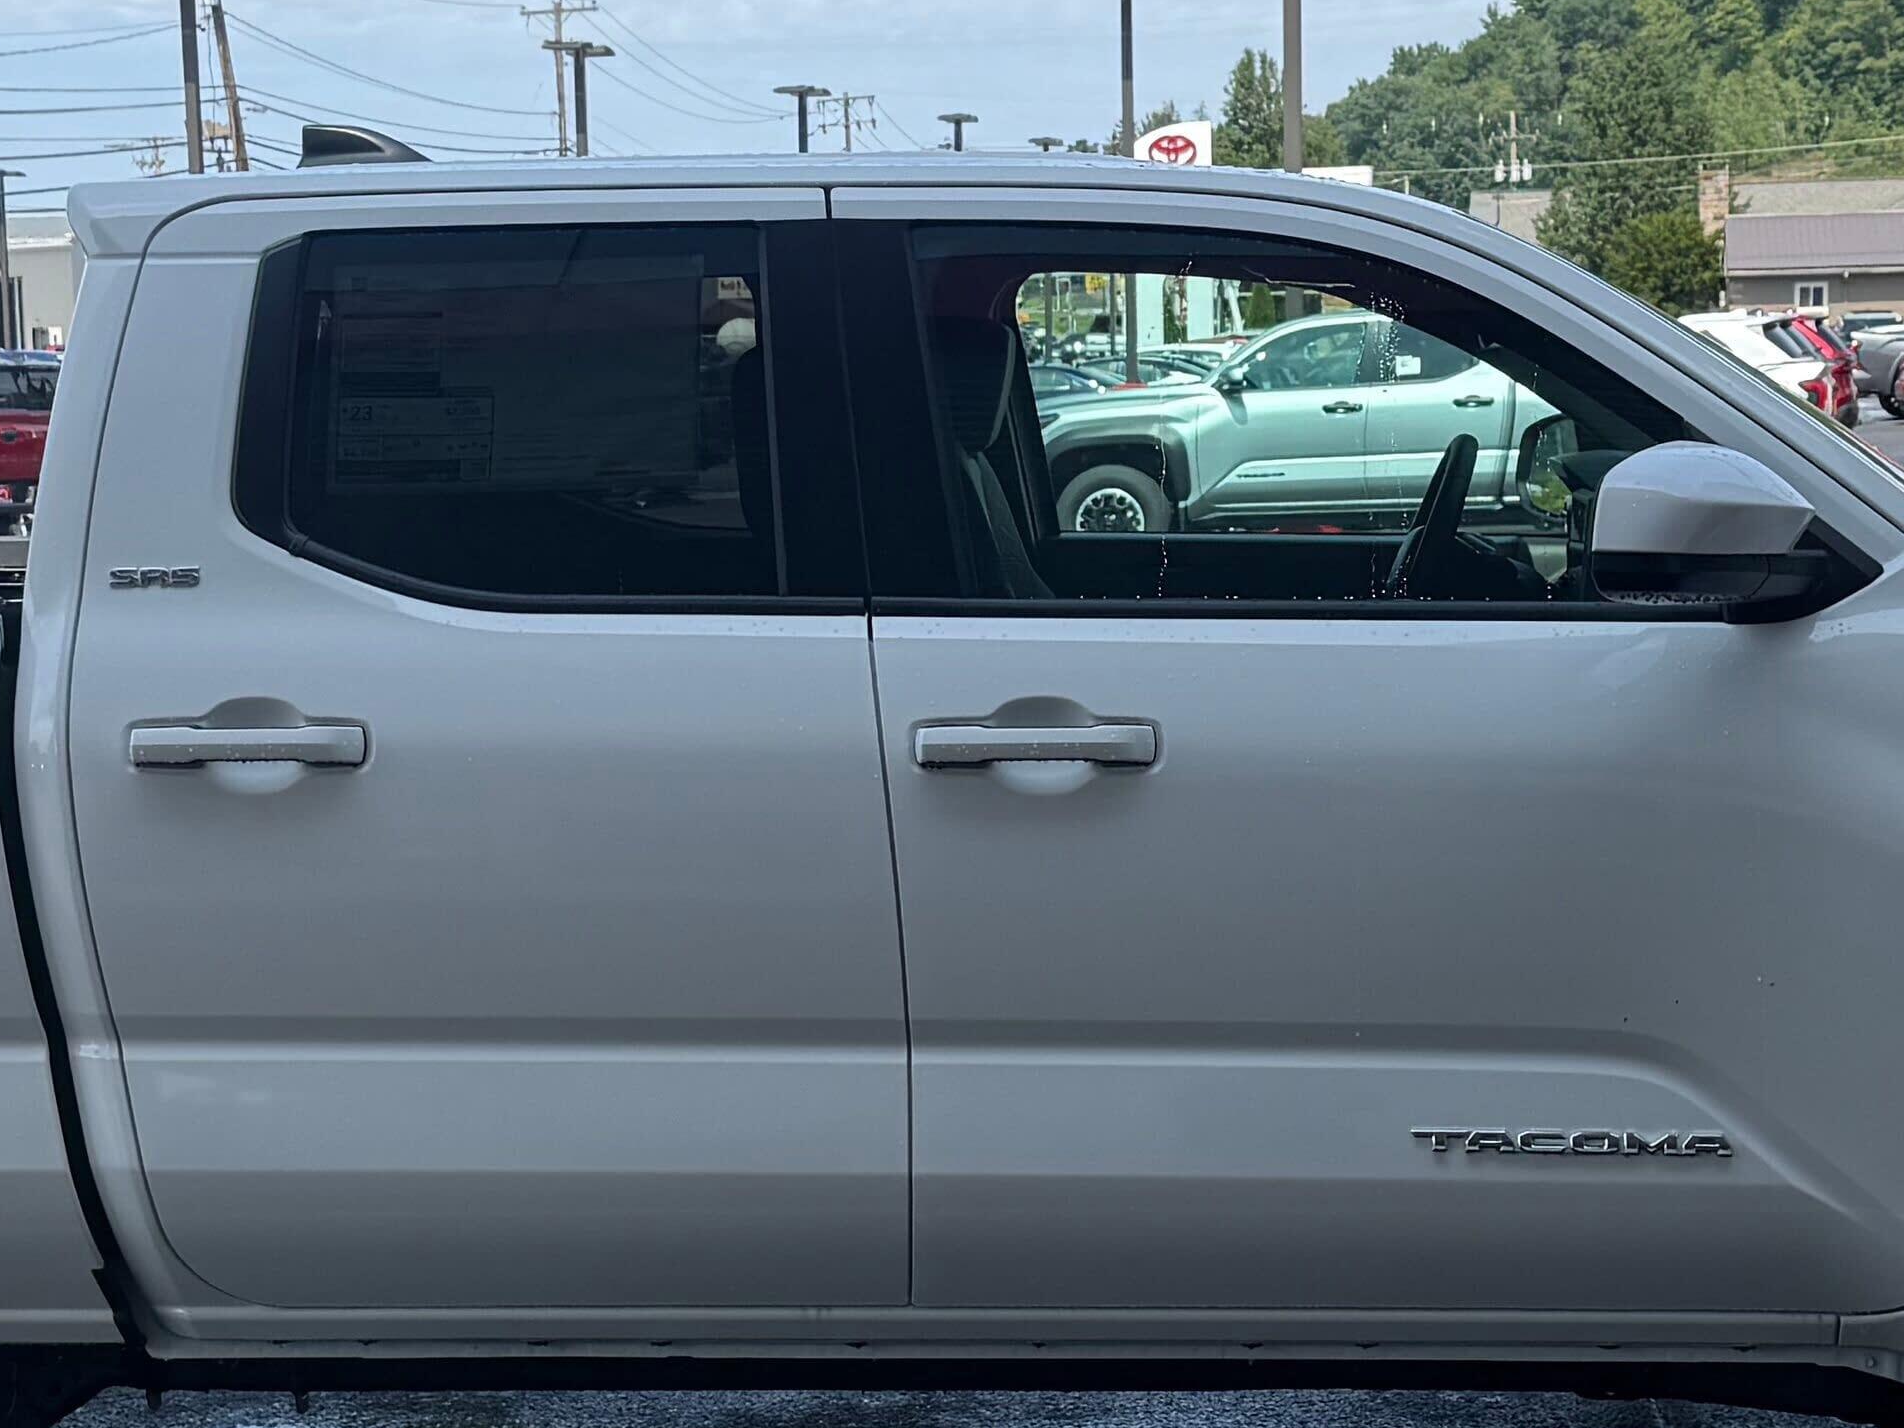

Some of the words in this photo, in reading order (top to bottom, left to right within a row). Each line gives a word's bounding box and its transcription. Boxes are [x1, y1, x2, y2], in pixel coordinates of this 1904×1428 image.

[351, 405, 373, 421] 23
[109, 566, 200, 589] SR5
[1409, 1128, 1733, 1157] TACOMA
